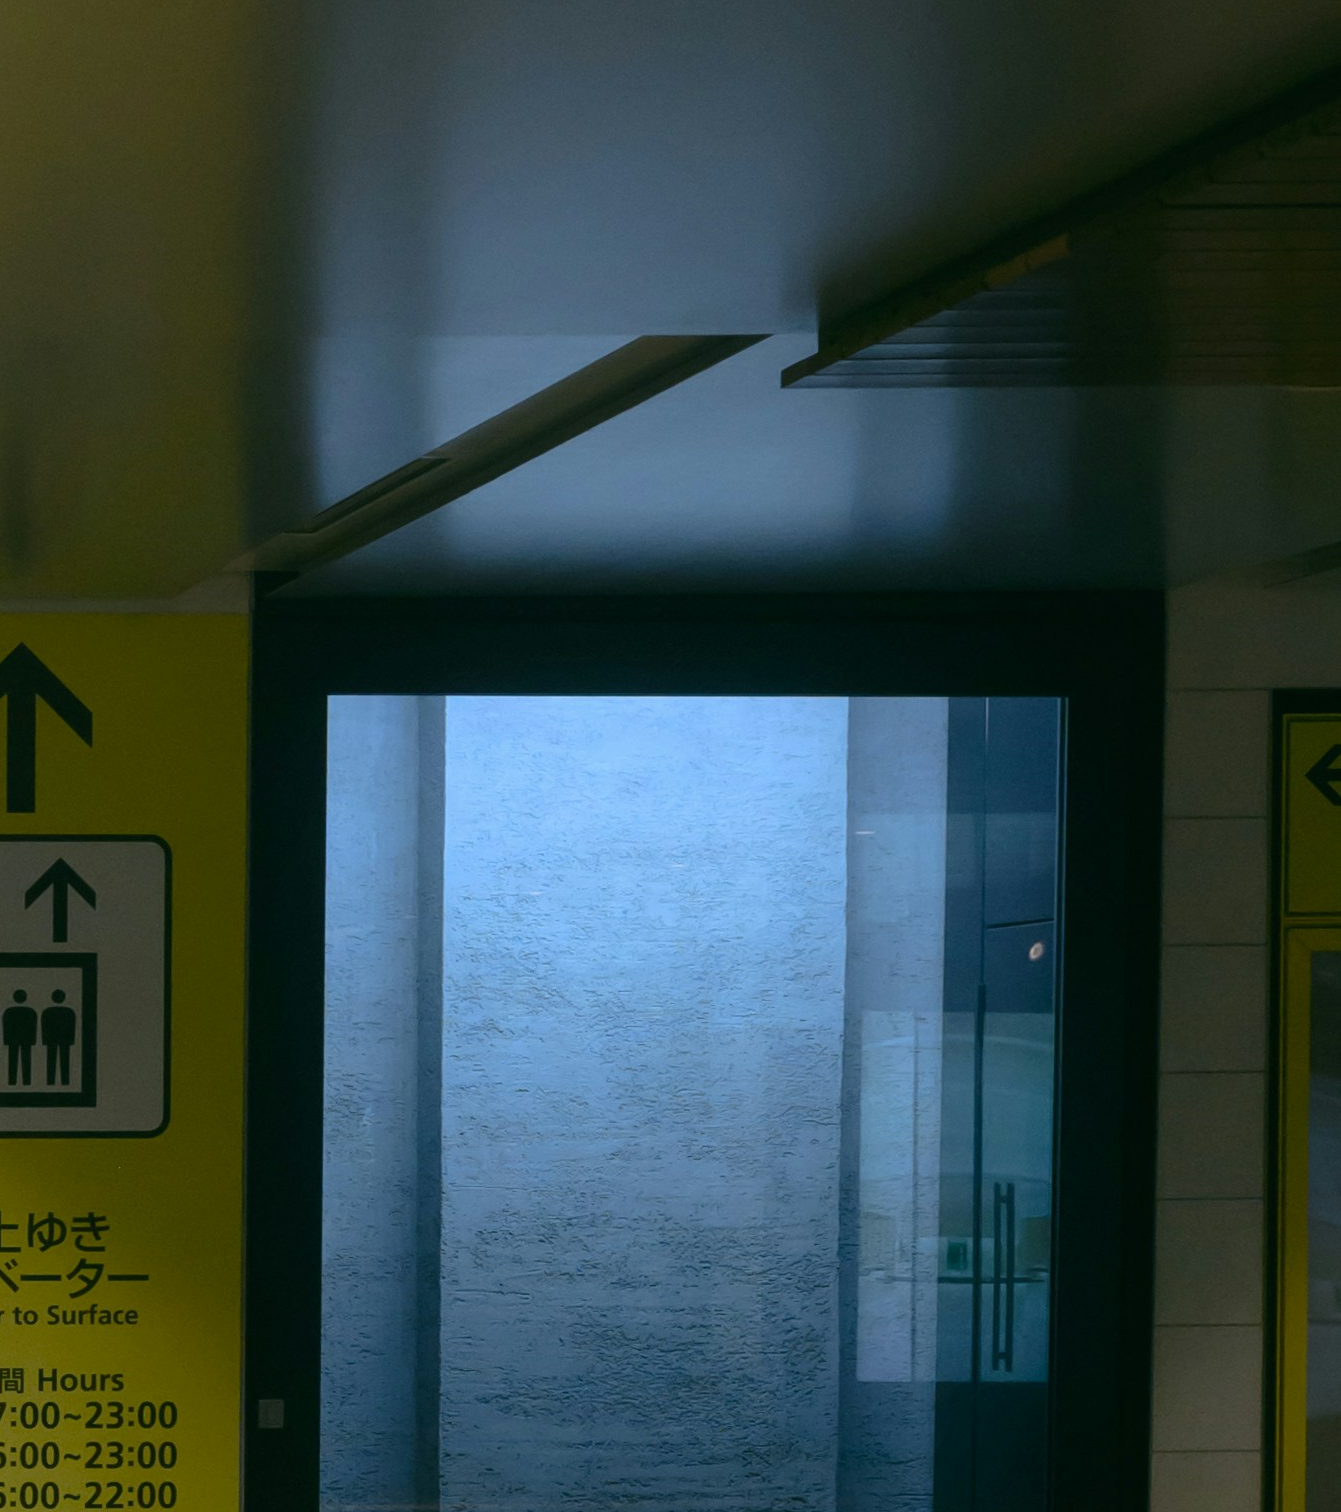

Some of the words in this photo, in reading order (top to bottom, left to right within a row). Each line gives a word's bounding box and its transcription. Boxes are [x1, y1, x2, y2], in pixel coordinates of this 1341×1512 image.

[13, 1306, 38, 1326] to
[47, 1304, 139, 1326] Surface
[37, 1368, 125, 1392] Hours
